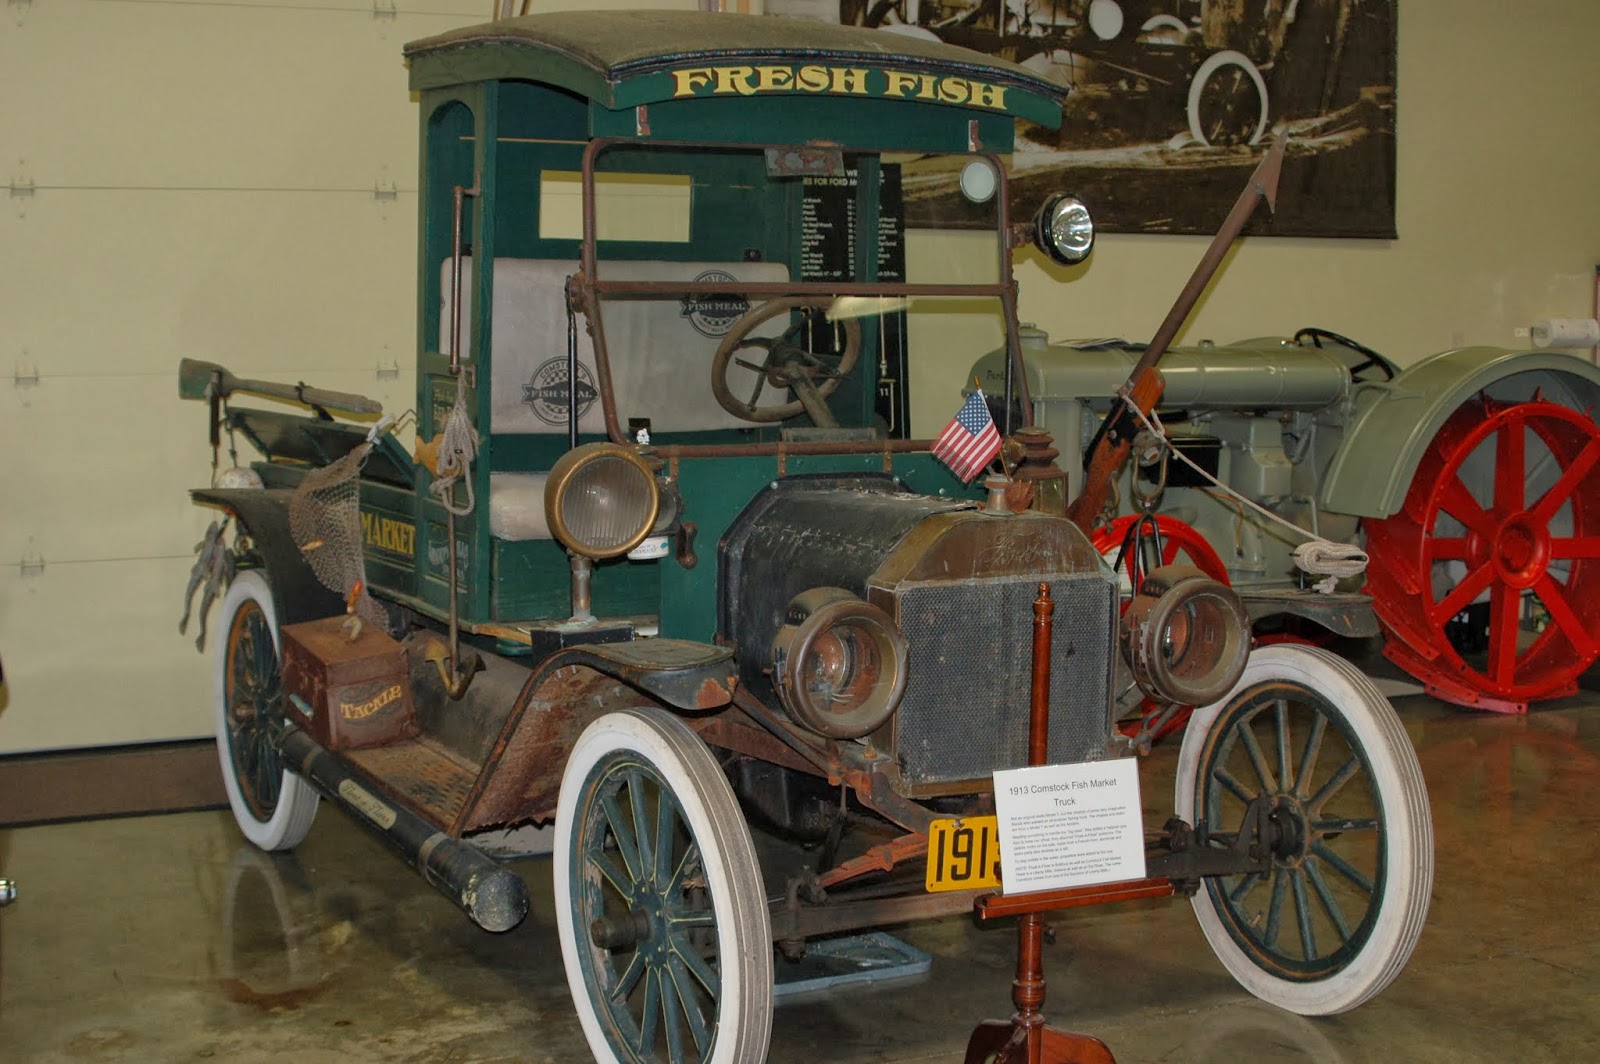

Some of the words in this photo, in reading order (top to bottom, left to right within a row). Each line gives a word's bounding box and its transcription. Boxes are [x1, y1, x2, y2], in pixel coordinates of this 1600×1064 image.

[672, 65, 870, 97] FRESH
[883, 69, 1007, 110] FISH
[814, 178, 828, 186] FOR
[829, 178, 848, 186] FORD
[359, 510, 417, 556] MARKET
[340, 685, 402, 719] TACKLE
[1009, 786, 1029, 795] 1913
[1030, 781, 1070, 793] Comstock
[1071, 780, 1089, 790] Fish
[1090, 778, 1118, 788] Market
[1053, 797, 1076, 807] Truck
